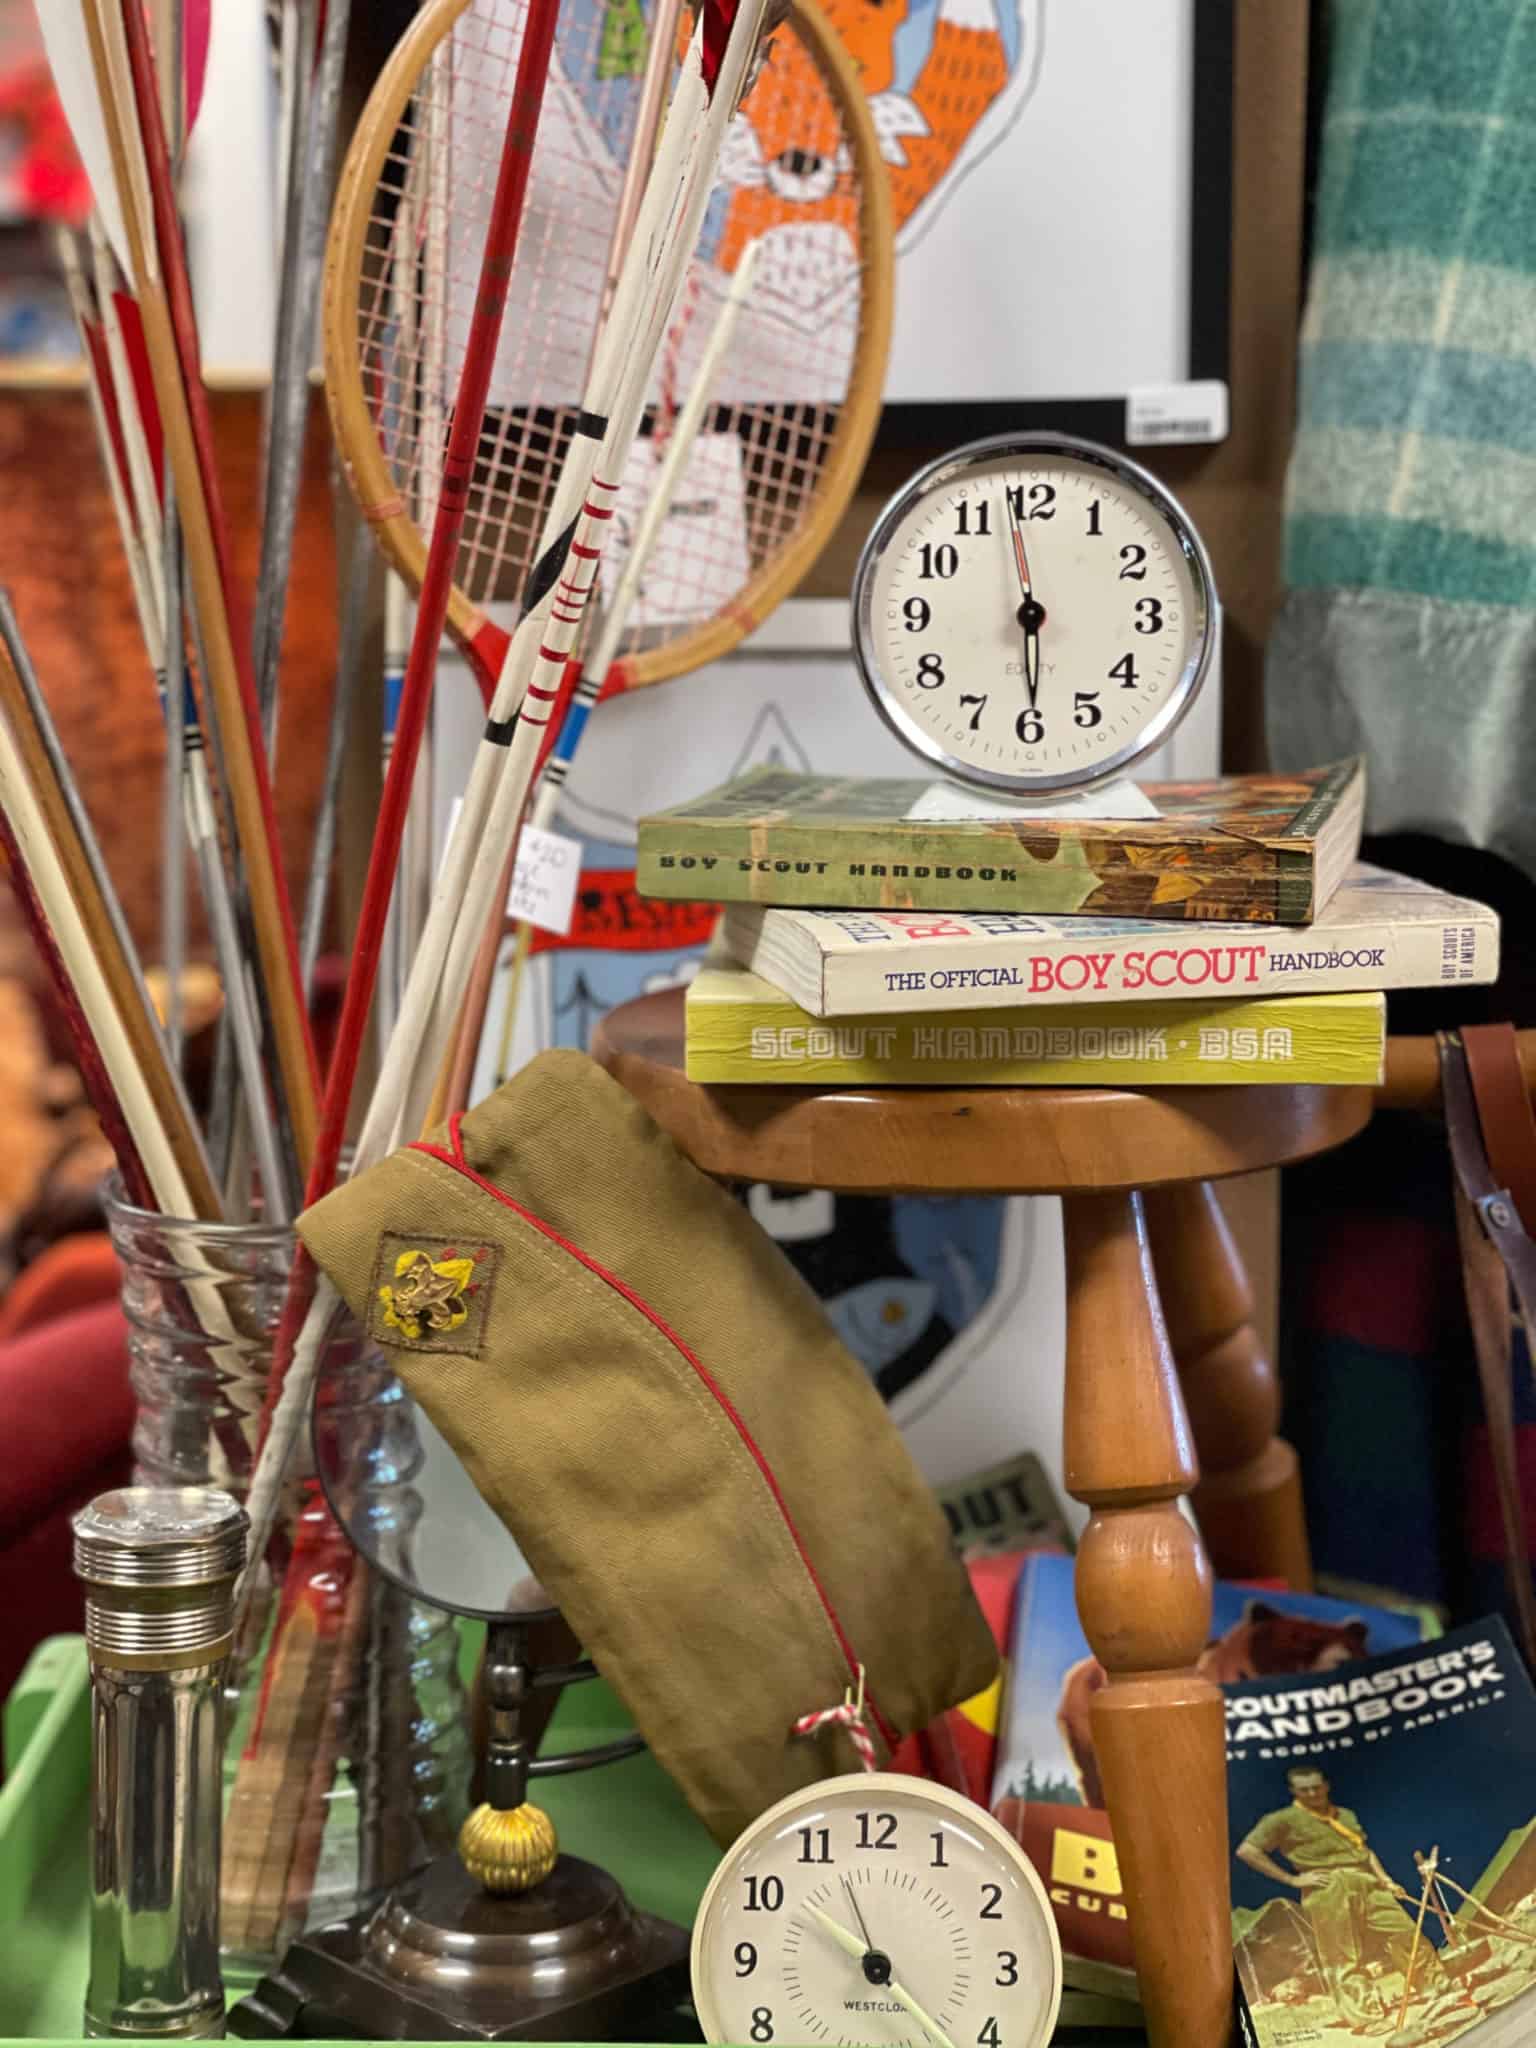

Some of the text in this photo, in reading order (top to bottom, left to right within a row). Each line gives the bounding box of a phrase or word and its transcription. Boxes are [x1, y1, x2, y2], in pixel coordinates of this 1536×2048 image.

[954, 500, 992, 536] 11
[1006, 484, 1056, 520] 12
[1086, 500, 1103, 536] 1
[918, 543, 959, 579] 10
[1119, 545, 1147, 580] 2
[902, 597, 931, 633] 9
[1134, 598, 1163, 634] 3
[916, 654, 945, 689] 8
[1005, 663, 1056, 674] EQTY
[1108, 653, 1139, 688] 4
[959, 694, 987, 730] 7
[1015, 709, 1044, 744] 6
[1074, 692, 1101, 727] 5
[660, 856, 1017, 881] BOY SCOUT HANDBOOK
[1441, 928, 1457, 979] BOY SCOUTS
[1460, 928, 1475, 963] AMERICA
[885, 945, 1385, 993] THE OFFICIAL BOY SCOUT HANDBOOK
[751, 1027, 1293, 1061] SCOUT HANDBOOK BSA
[1225, 1662, 1505, 1742] ANDBOOK
[1259, 1736, 1354, 1759] SCOUTS
[1364, 1726, 1392, 1742] OF
[1404, 1690, 1505, 1731] AMERICA
[797, 1828, 835, 1864] 11
[855, 1813, 898, 1850] 12
[930, 1832, 949, 1868] 1
[743, 1876, 785, 1912] 10
[979, 1884, 1003, 1920] 2
[734, 1942, 758, 1978] 9
[995, 1952, 1019, 1987] 3
[750, 2007, 774, 2043] 8
[977, 2016, 1003, 2048] 4
